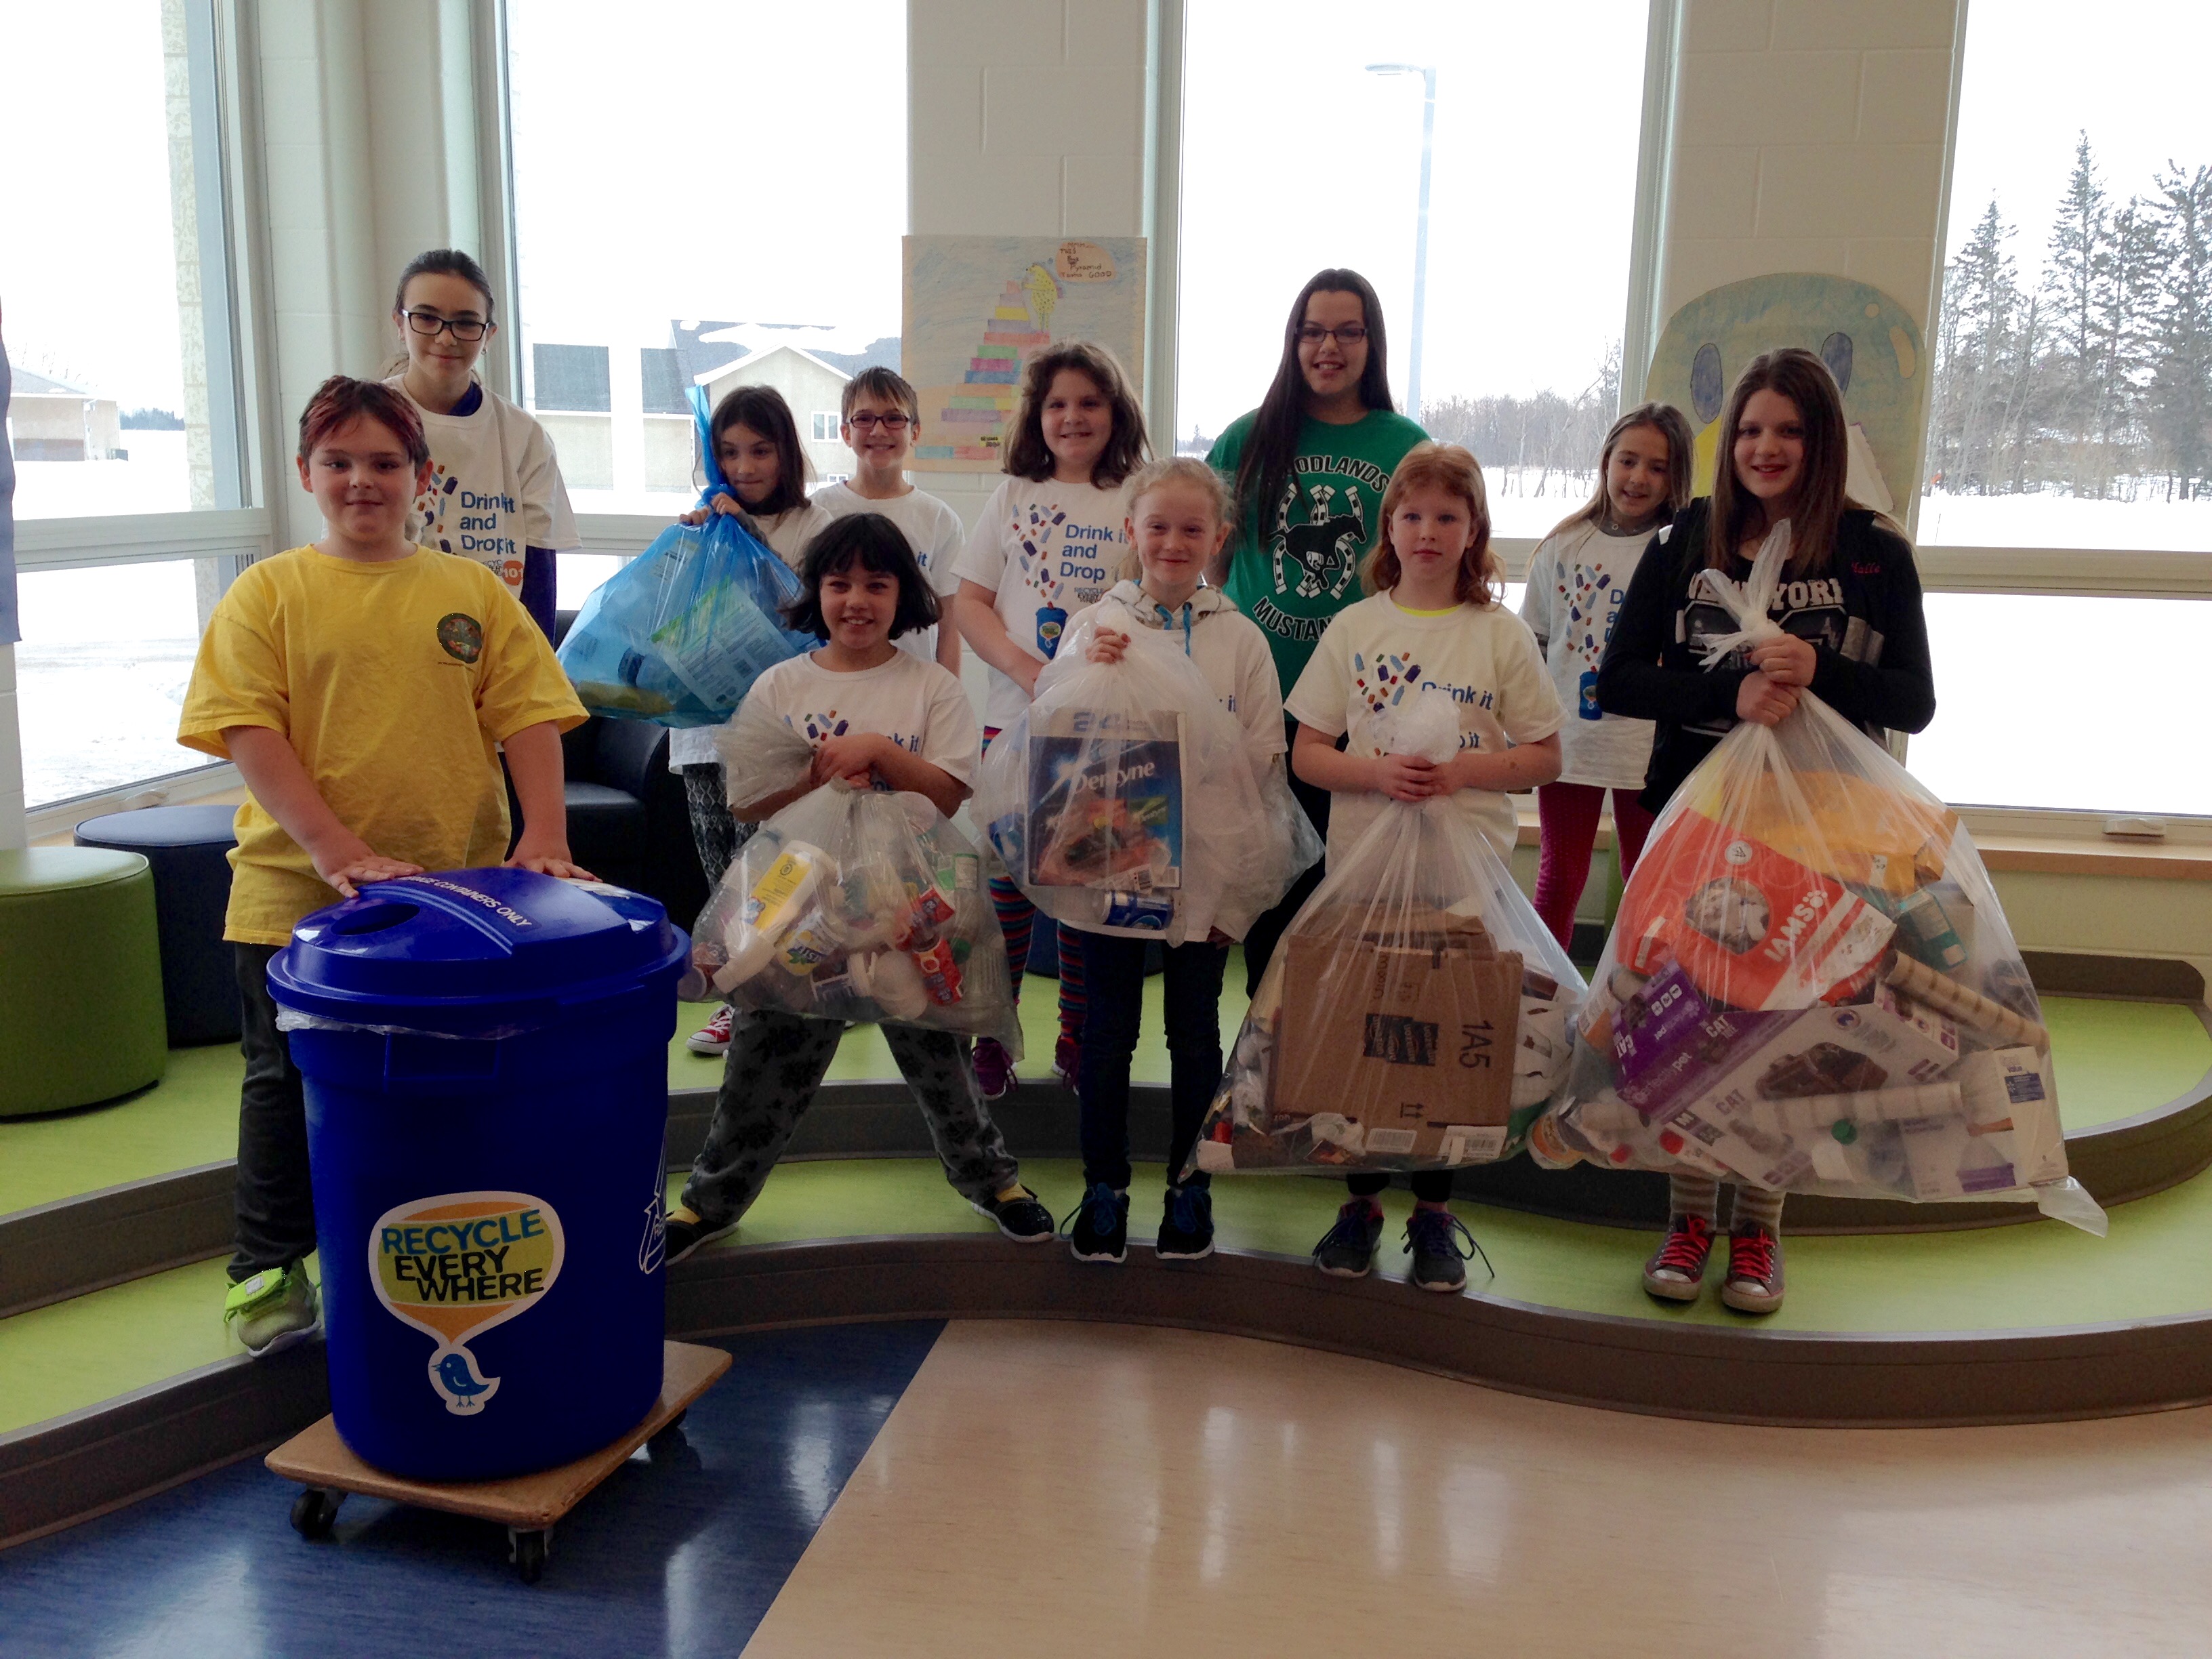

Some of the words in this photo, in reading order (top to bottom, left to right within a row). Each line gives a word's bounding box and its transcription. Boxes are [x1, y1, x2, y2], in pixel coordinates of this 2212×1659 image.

[1293, 455, 1390, 493] ODLANDS
[460, 513, 497, 531] and
[1065, 524, 1113, 541] Drink
[916, 551, 928, 567] it
[1062, 544, 1097, 558] and
[1060, 562, 1105, 583] Drop
[1252, 596, 1338, 642] MUSTAN
[1479, 690, 1494, 710] it
[909, 734, 920, 752] it
[1469, 731, 1480, 748] it
[1076, 762, 1155, 793] Denyne
[436, 881, 502, 908] CONTAINERS
[496, 907, 533, 926] ONLY
[1764, 904, 1816, 962] IAMS
[1705, 1015, 1729, 1038] CAT
[1403, 1023, 1416, 1063] amazon
[1422, 1025, 1435, 1065] amazon
[1458, 1019, 1495, 1070] 1A5
[1715, 1088, 1746, 1117] CAT
[380, 1208, 546, 1255] RECYCLE
[394, 1245, 510, 1282] EVERY
[416, 1267, 545, 1302] WHERE
